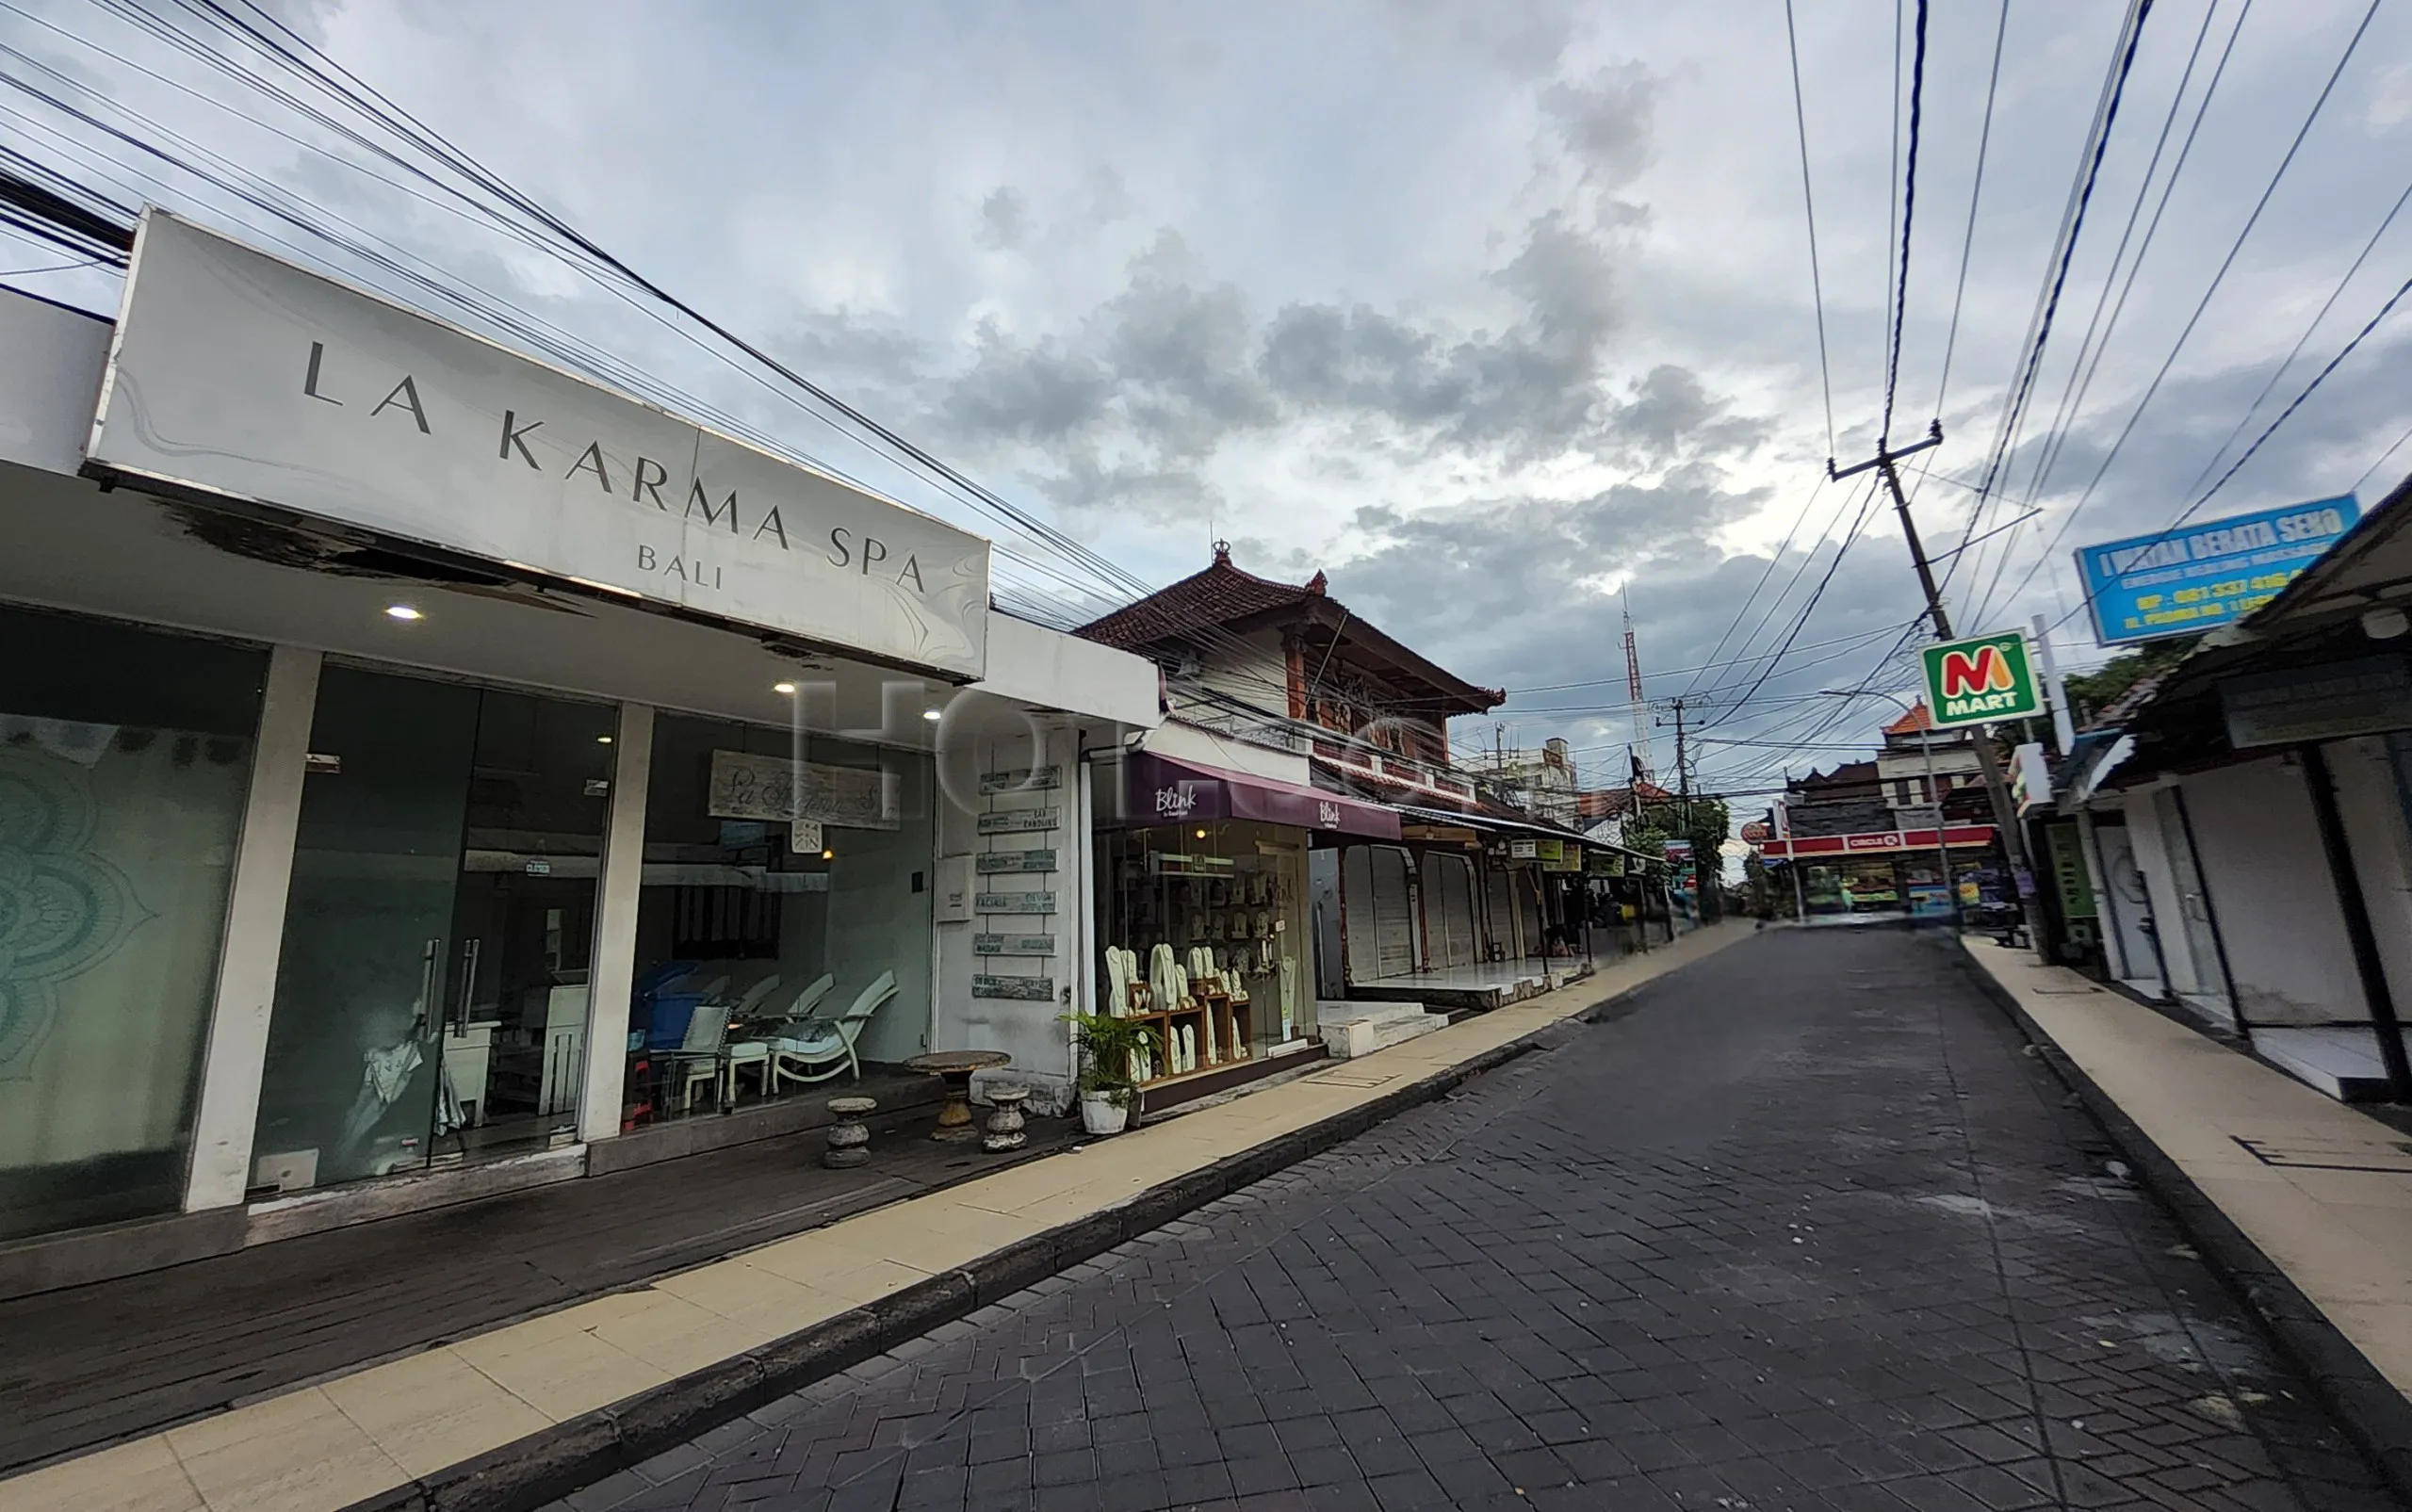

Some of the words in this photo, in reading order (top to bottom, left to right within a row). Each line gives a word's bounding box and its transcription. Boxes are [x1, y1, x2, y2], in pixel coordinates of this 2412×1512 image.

[302, 340, 432, 436] LA
[497, 409, 791, 551] KARMA
[828, 526, 927, 594] SPA
[636, 543, 723, 592] BALI
[1947, 691, 2017, 716] MART
[1155, 785, 1197, 811] Blink
[1319, 801, 1341, 823] Blink
